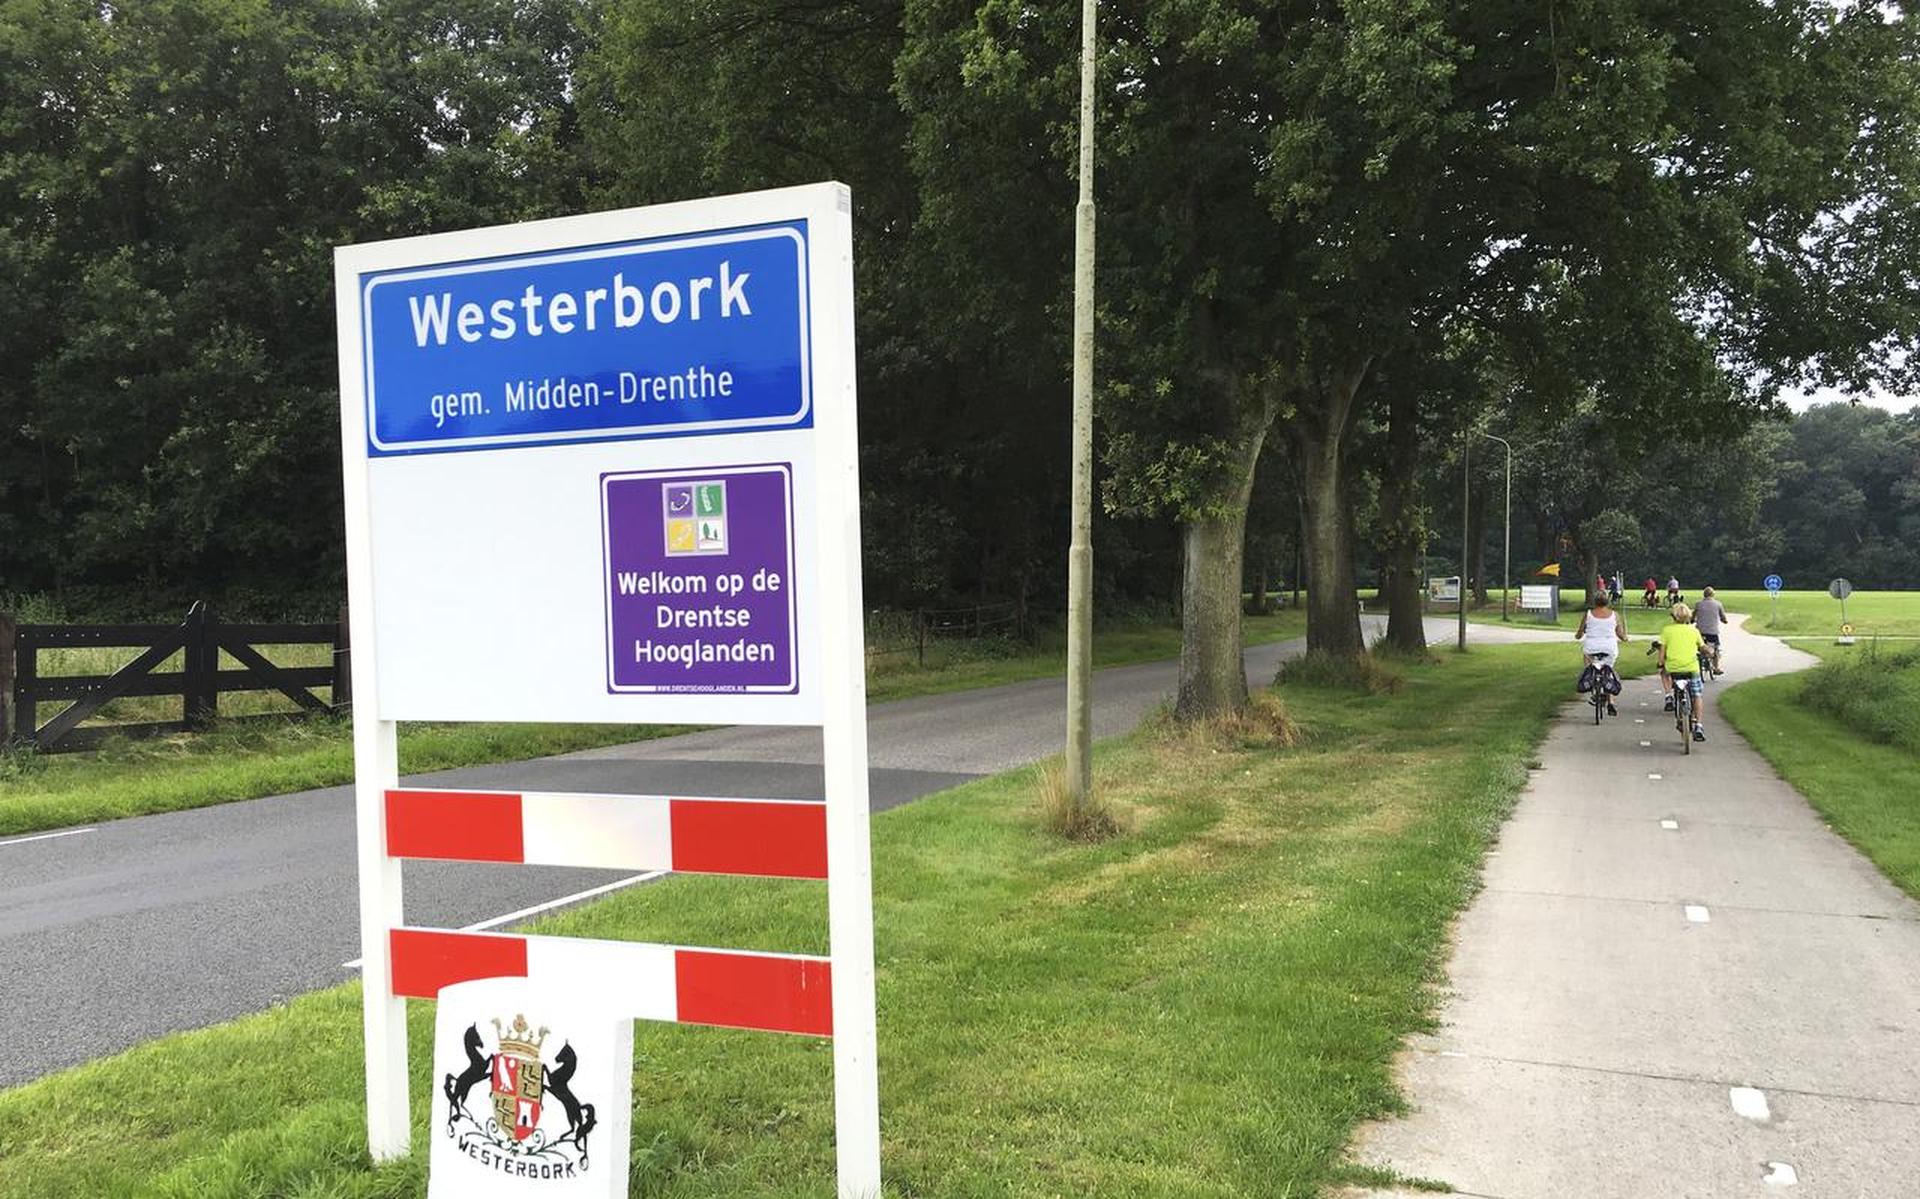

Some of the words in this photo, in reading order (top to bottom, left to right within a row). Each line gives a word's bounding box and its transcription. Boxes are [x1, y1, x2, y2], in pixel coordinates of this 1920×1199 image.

[410, 261, 752, 346] Westerbork
[432, 392, 490, 427] gem.
[507, 366, 733, 412] Midden-Drenthe
[618, 571, 706, 595] Welkom
[716, 574, 744, 596] op
[753, 569, 780, 592] de
[658, 606, 750, 627] Drentse
[636, 640, 774, 669] Hooglanden
[458, 1136, 576, 1179] WESTERBORK
